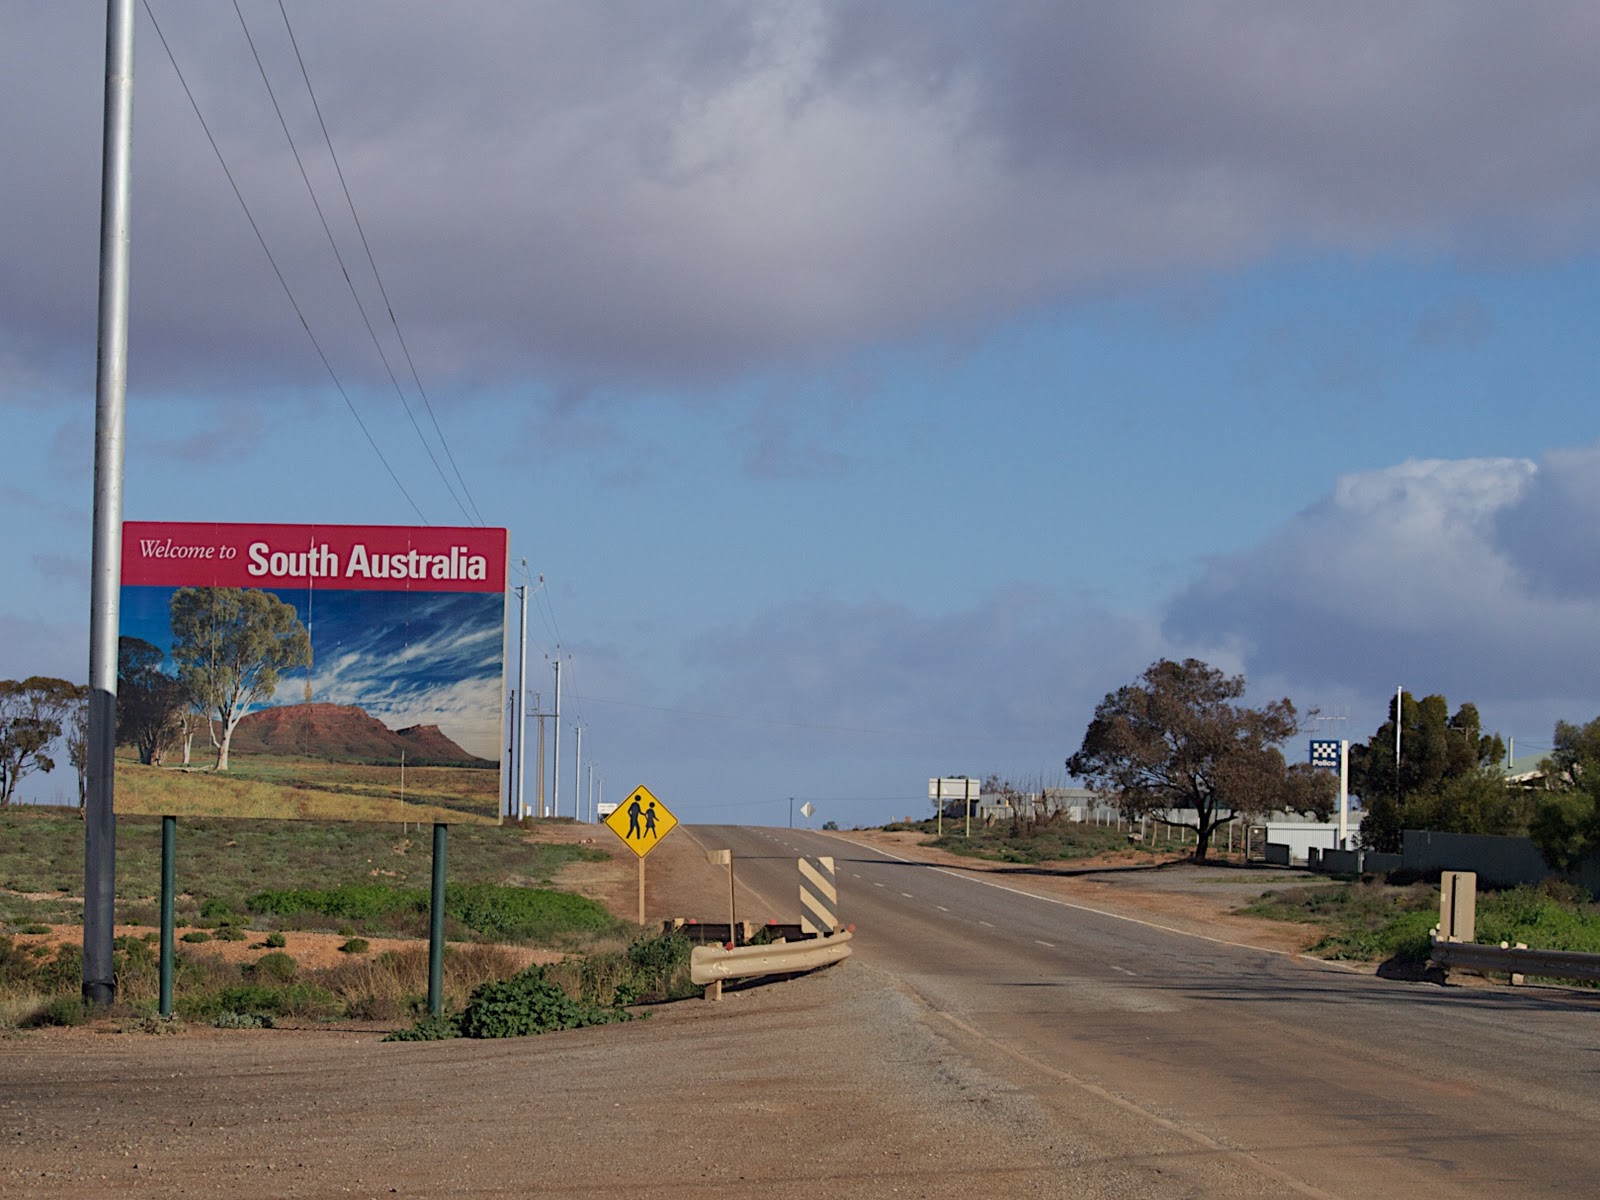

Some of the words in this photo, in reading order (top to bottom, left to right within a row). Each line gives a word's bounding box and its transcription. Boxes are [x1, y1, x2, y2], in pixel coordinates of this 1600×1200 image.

[140, 538, 215, 559] Welcome
[219, 545, 237, 559] to
[247, 542, 339, 577] South
[345, 544, 487, 580] Australia
[1312, 759, 1337, 767] Police
